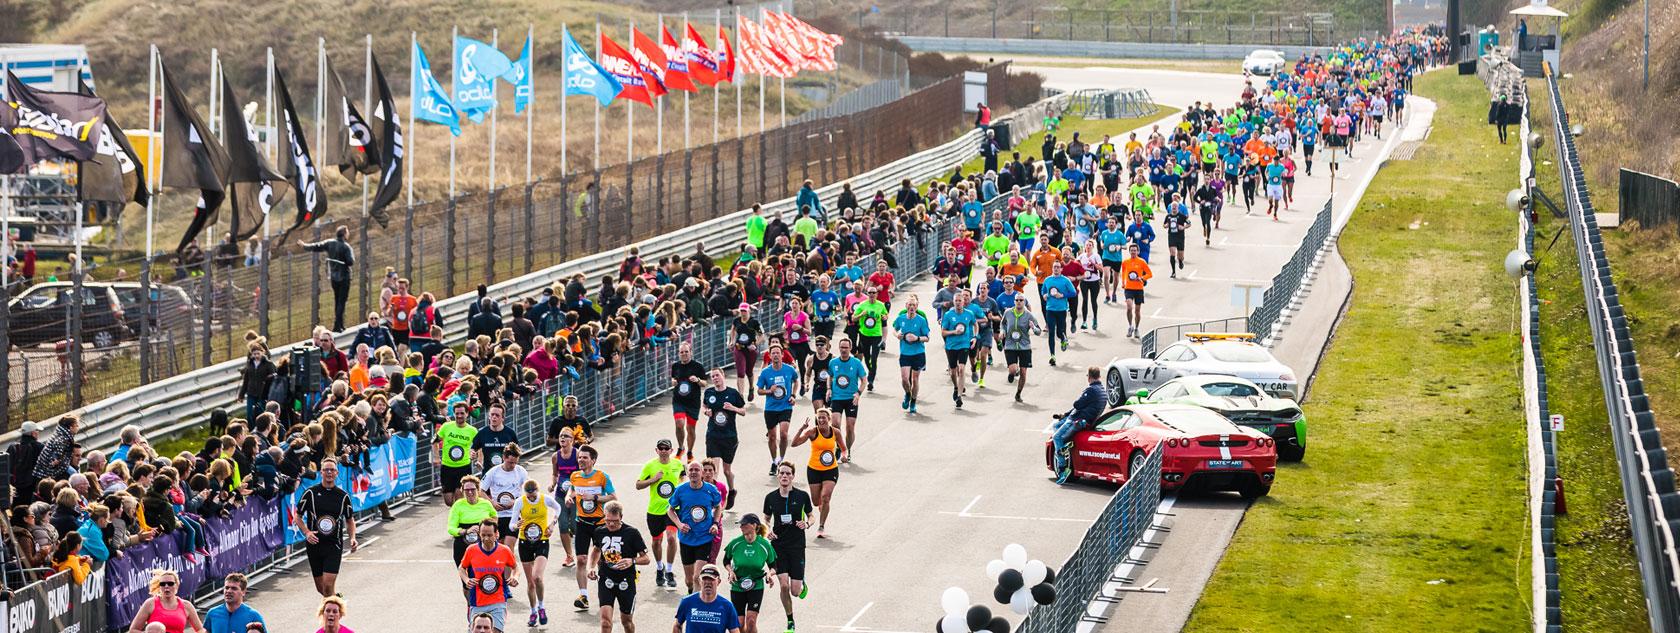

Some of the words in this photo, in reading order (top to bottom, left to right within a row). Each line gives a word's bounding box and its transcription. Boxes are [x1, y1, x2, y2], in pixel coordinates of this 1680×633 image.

[1270, 382, 1288, 391] CAR
[1552, 417, 1560, 429] F
[448, 432, 470, 441] Aureus
[240, 519, 251, 546] City
[601, 536, 622, 554] 25
[47, 583, 70, 620] BUKO
[9, 598, 36, 633] BUKO
